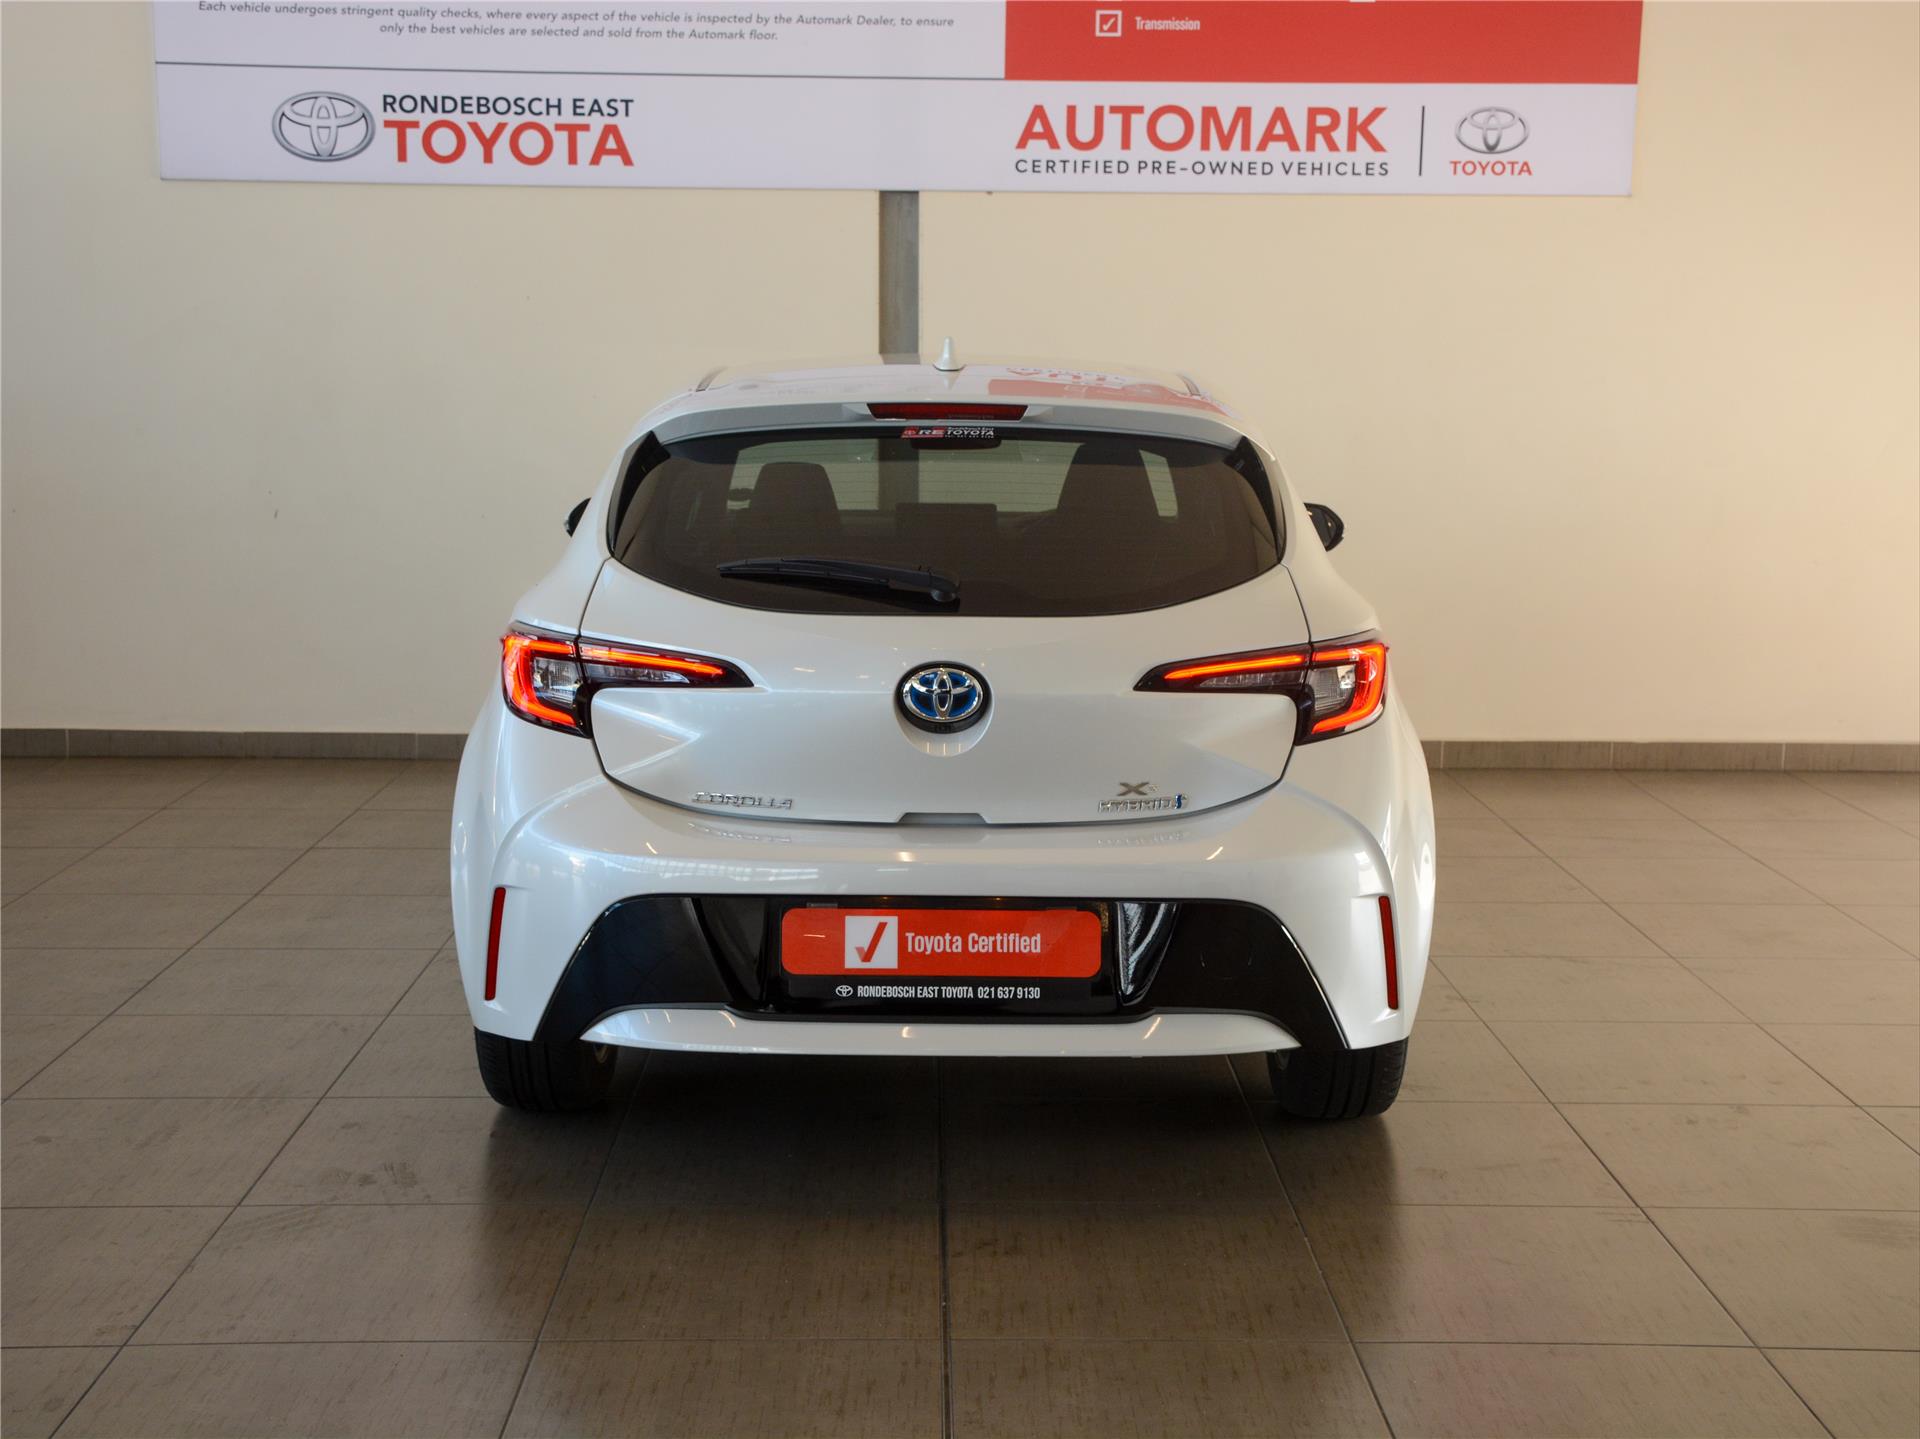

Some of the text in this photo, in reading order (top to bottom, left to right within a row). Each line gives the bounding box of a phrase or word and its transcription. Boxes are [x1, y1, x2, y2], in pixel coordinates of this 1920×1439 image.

[198, 1, 954, 27] Each vehicle undergoes stringent quality checks, where every aspect of the vehicle is inspected by the Automark Dealer, to ensure
[1135, 16, 1200, 32] Transmission
[379, 23, 778, 40] only the best vehicles are selected and sold from the Automark floor.
[382, 95, 634, 118] RONDEBOSCH EAST
[1015, 104, 1388, 153] AUTOMARK
[383, 120, 634, 167] TOYOTA
[1015, 158, 1389, 177] CERTIFIED PRE-OWNED VEHICLES
[1449, 161, 1533, 177] TOYOTA
[905, 932, 1041, 955] Toyota Certified
[857, 986, 1040, 999] RONDEBOSCH EAST TOYOTA 021 637 9130
